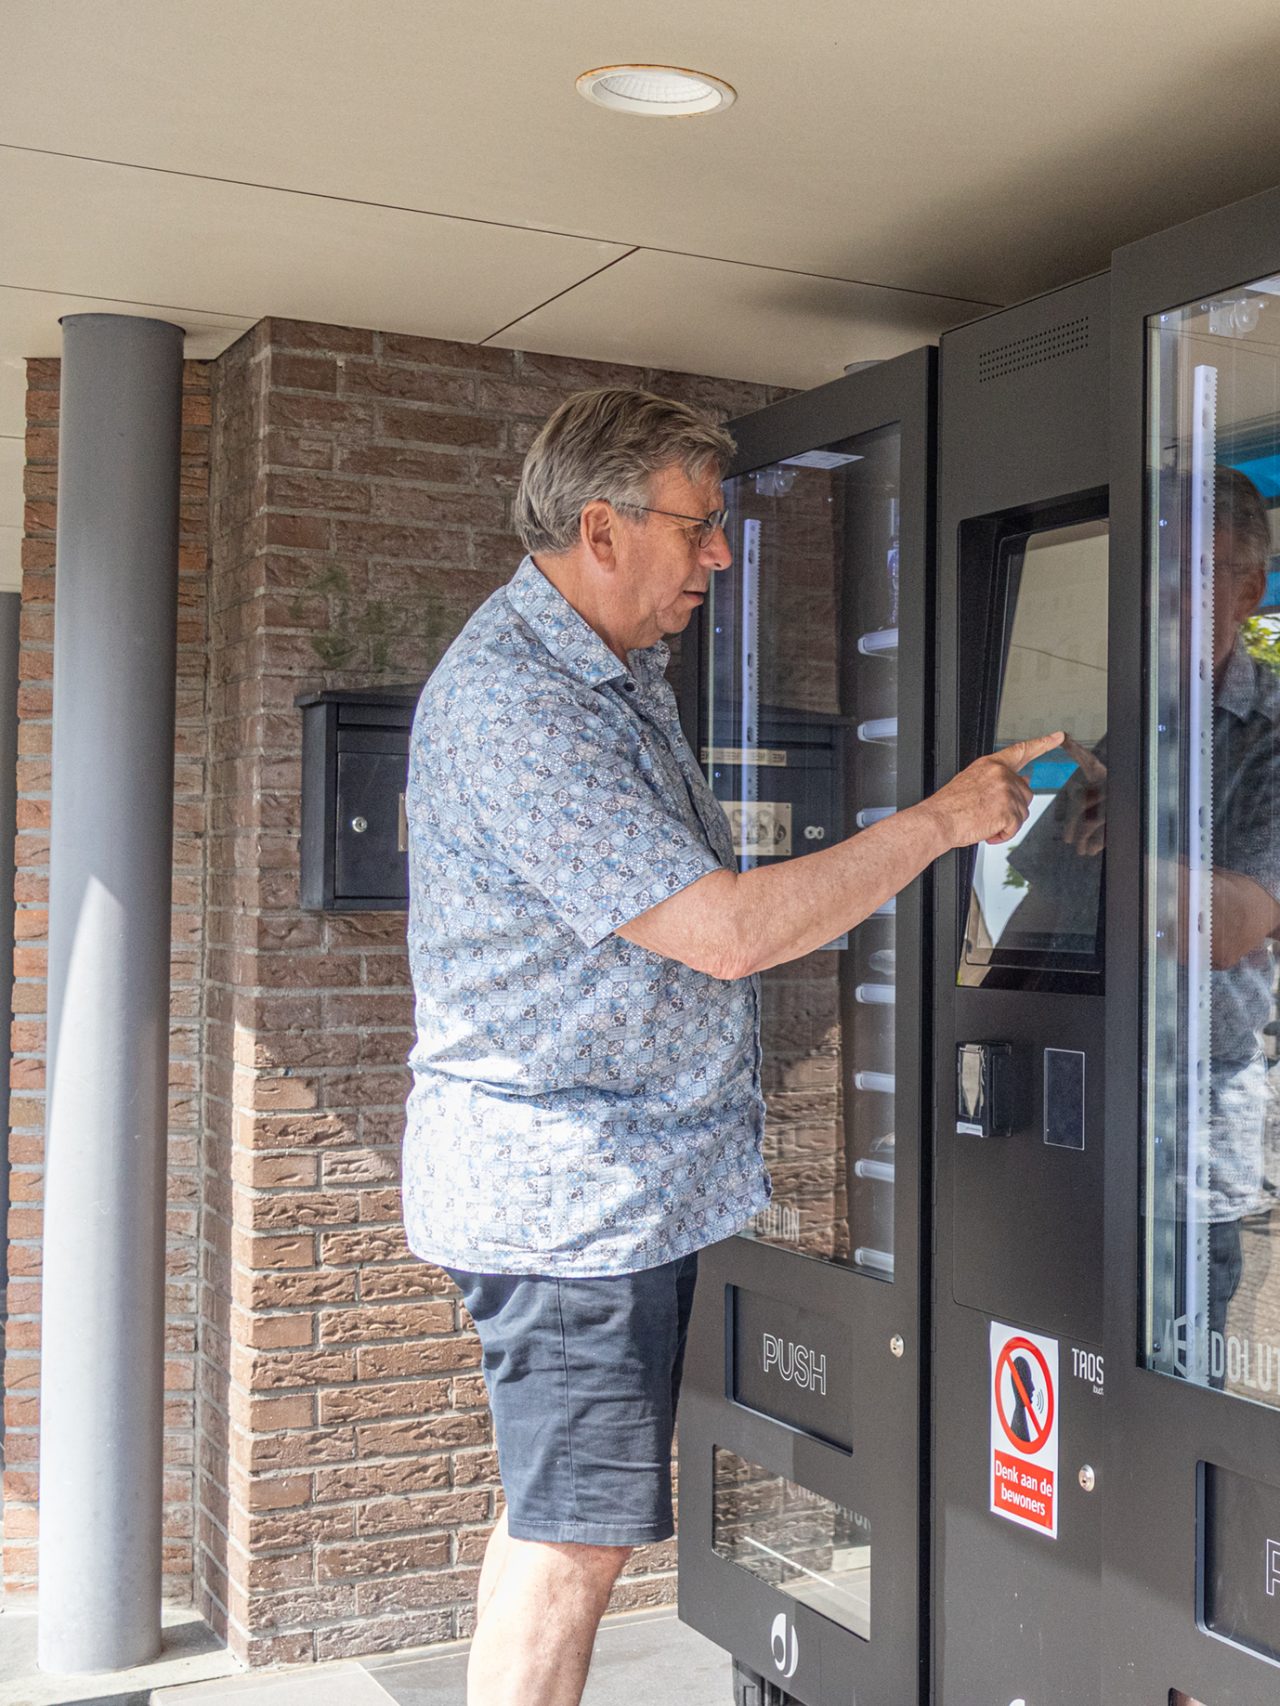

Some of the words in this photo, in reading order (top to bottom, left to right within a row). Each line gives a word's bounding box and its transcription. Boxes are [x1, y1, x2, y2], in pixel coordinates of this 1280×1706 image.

[762, 1332, 828, 1396] PUSH
[1071, 1348, 1104, 1385] TAOS
[995, 1459, 1018, 1484] Denk
[1020, 1473, 1038, 1491] aan
[1040, 1476, 1053, 1498] de
[1001, 1484, 1046, 1516] bewoners
